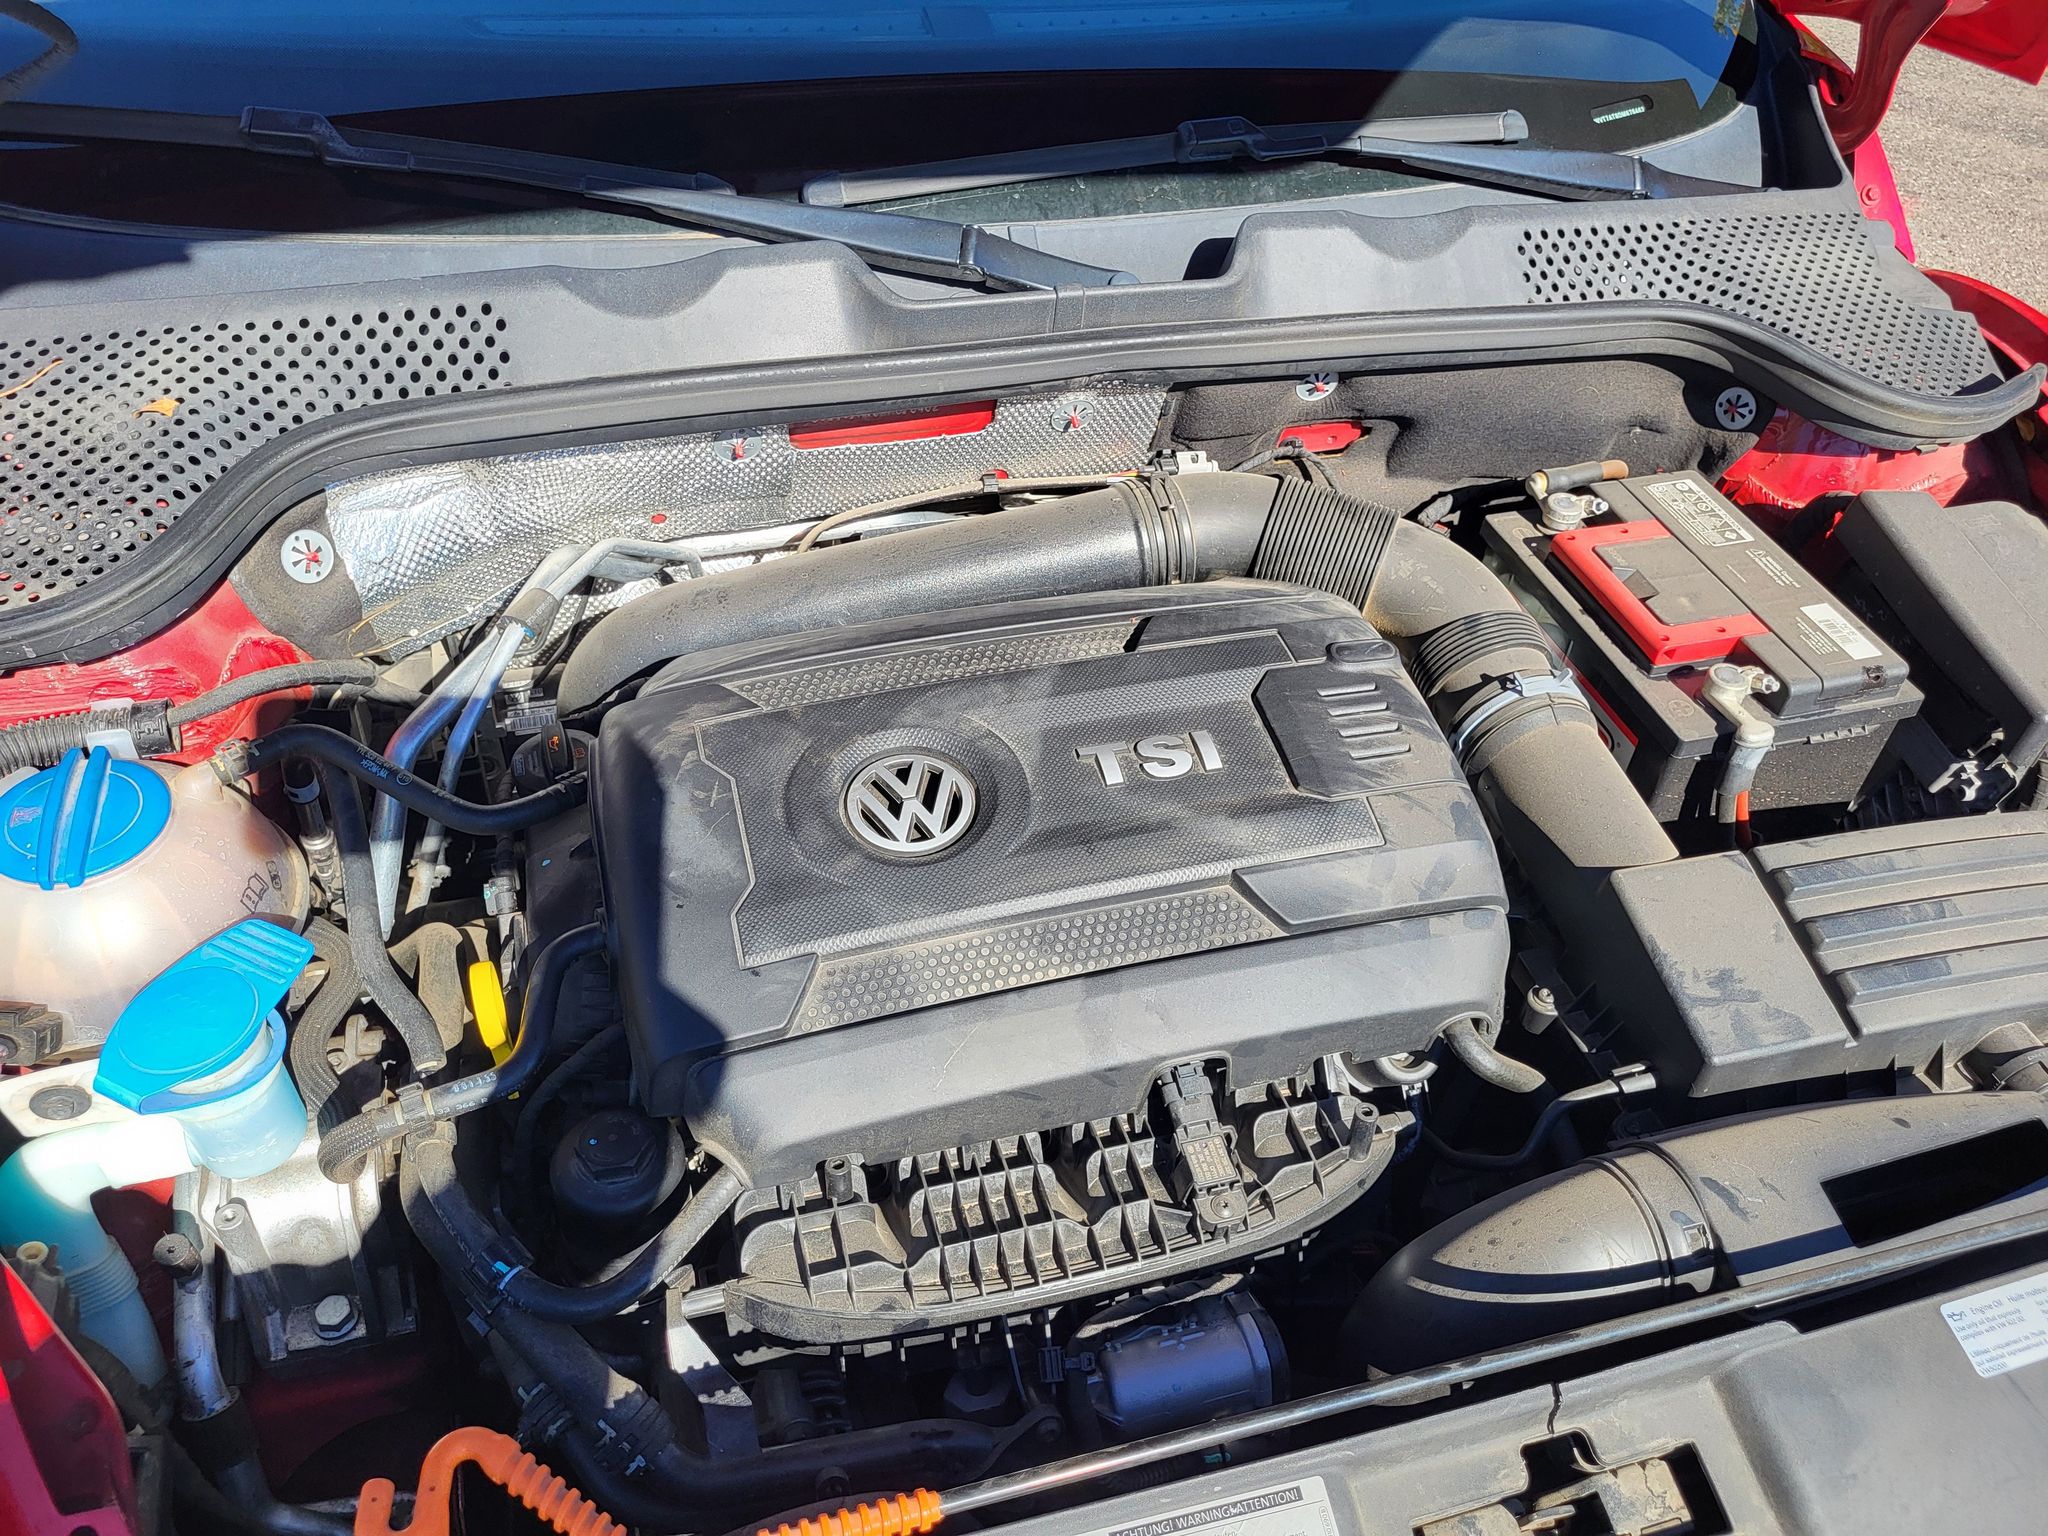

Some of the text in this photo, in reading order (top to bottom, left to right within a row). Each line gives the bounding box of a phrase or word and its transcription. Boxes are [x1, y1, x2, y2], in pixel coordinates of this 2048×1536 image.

[1075, 730, 1223, 786] TSI
[846, 753, 976, 852] VW
[1116, 1521, 1174, 1536] CHTUNG!
[1236, 1489, 1299, 1514] ATTENTION!
